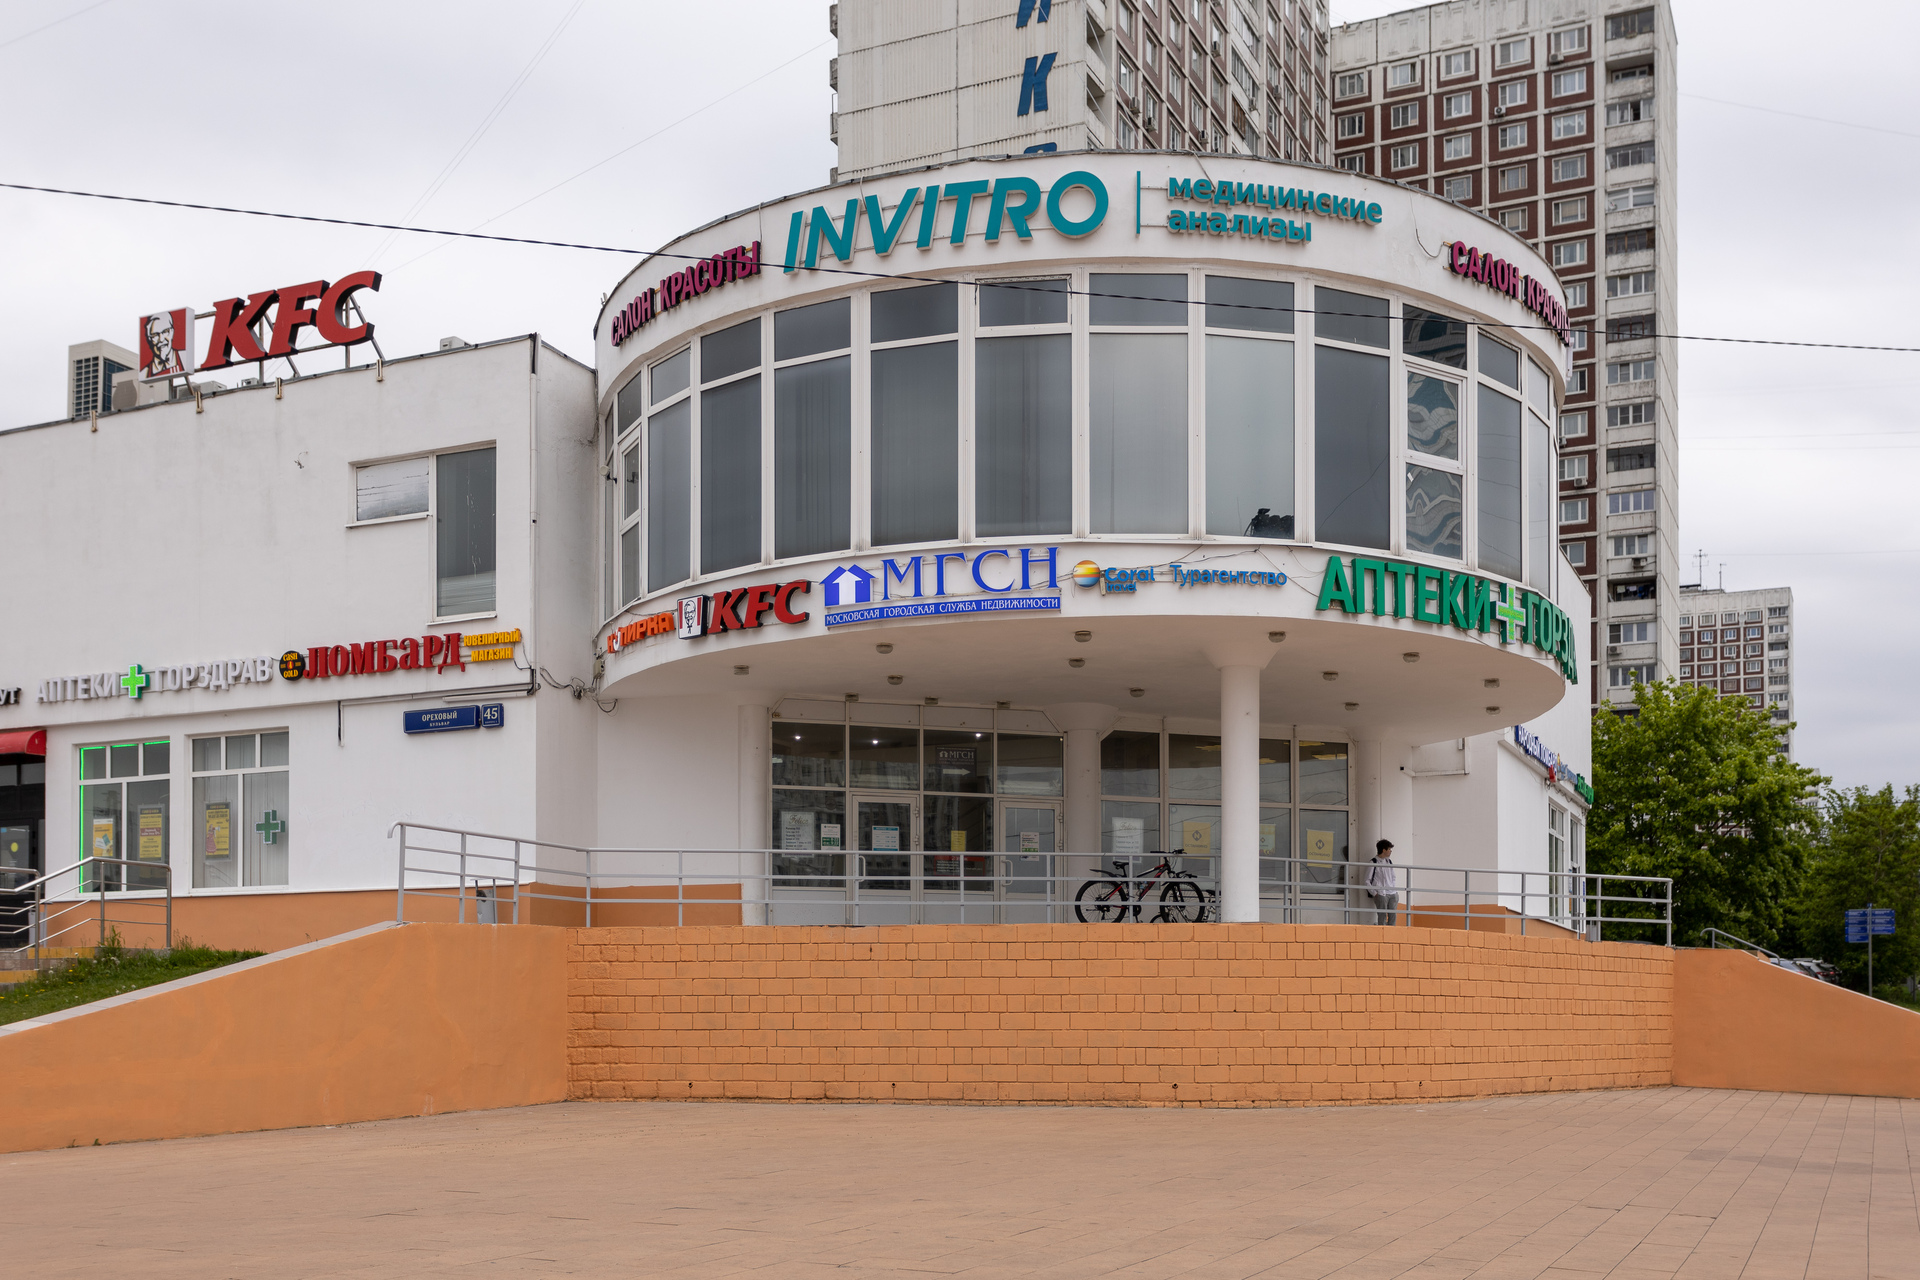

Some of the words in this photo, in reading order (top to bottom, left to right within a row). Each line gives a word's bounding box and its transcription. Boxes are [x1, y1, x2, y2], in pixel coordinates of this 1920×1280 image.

[1168, 177, 1383, 226] медицинские
[783, 171, 1109, 274] INVITRO
[1168, 209, 1312, 244] анализы
[611, 288, 655, 347] САЛОН
[660, 241, 760, 311] КРАСОТЫ
[1450, 240, 1519, 299] САЛОН
[1524, 275, 1571, 347] КРАСОТЫ
[201, 271, 382, 371] KFC
[881, 547, 1060, 600] МГСН
[1105, 566, 1155, 582] Coral
[1106, 582, 1137, 592] travel
[1169, 564, 1288, 588] Турагентство
[708, 579, 811, 634] KFC
[1315, 555, 1491, 633] АПТЕКИ
[826, 609, 880, 625] МОСКОВСКАЯ
[883, 604, 935, 617] ГОРОДСКАЯ
[939, 601, 977, 613] СЛУЖБА
[981, 597, 1058, 611] НЕДВИЖИМОСТИ
[463, 628, 521, 646] ЮВЕЛИРНЫЙ
[471, 647, 514, 662] МАГАЗИН
[37, 672, 119, 702] АПТЕКИ
[155, 656, 273, 692] ГОРЗДРАВ
[283, 669, 299, 678] GOLD
[422, 711, 458, 722] ОРЕХОВЫЙ
[484, 708, 498, 720] 45
[949, 751, 974, 759] МГСН
